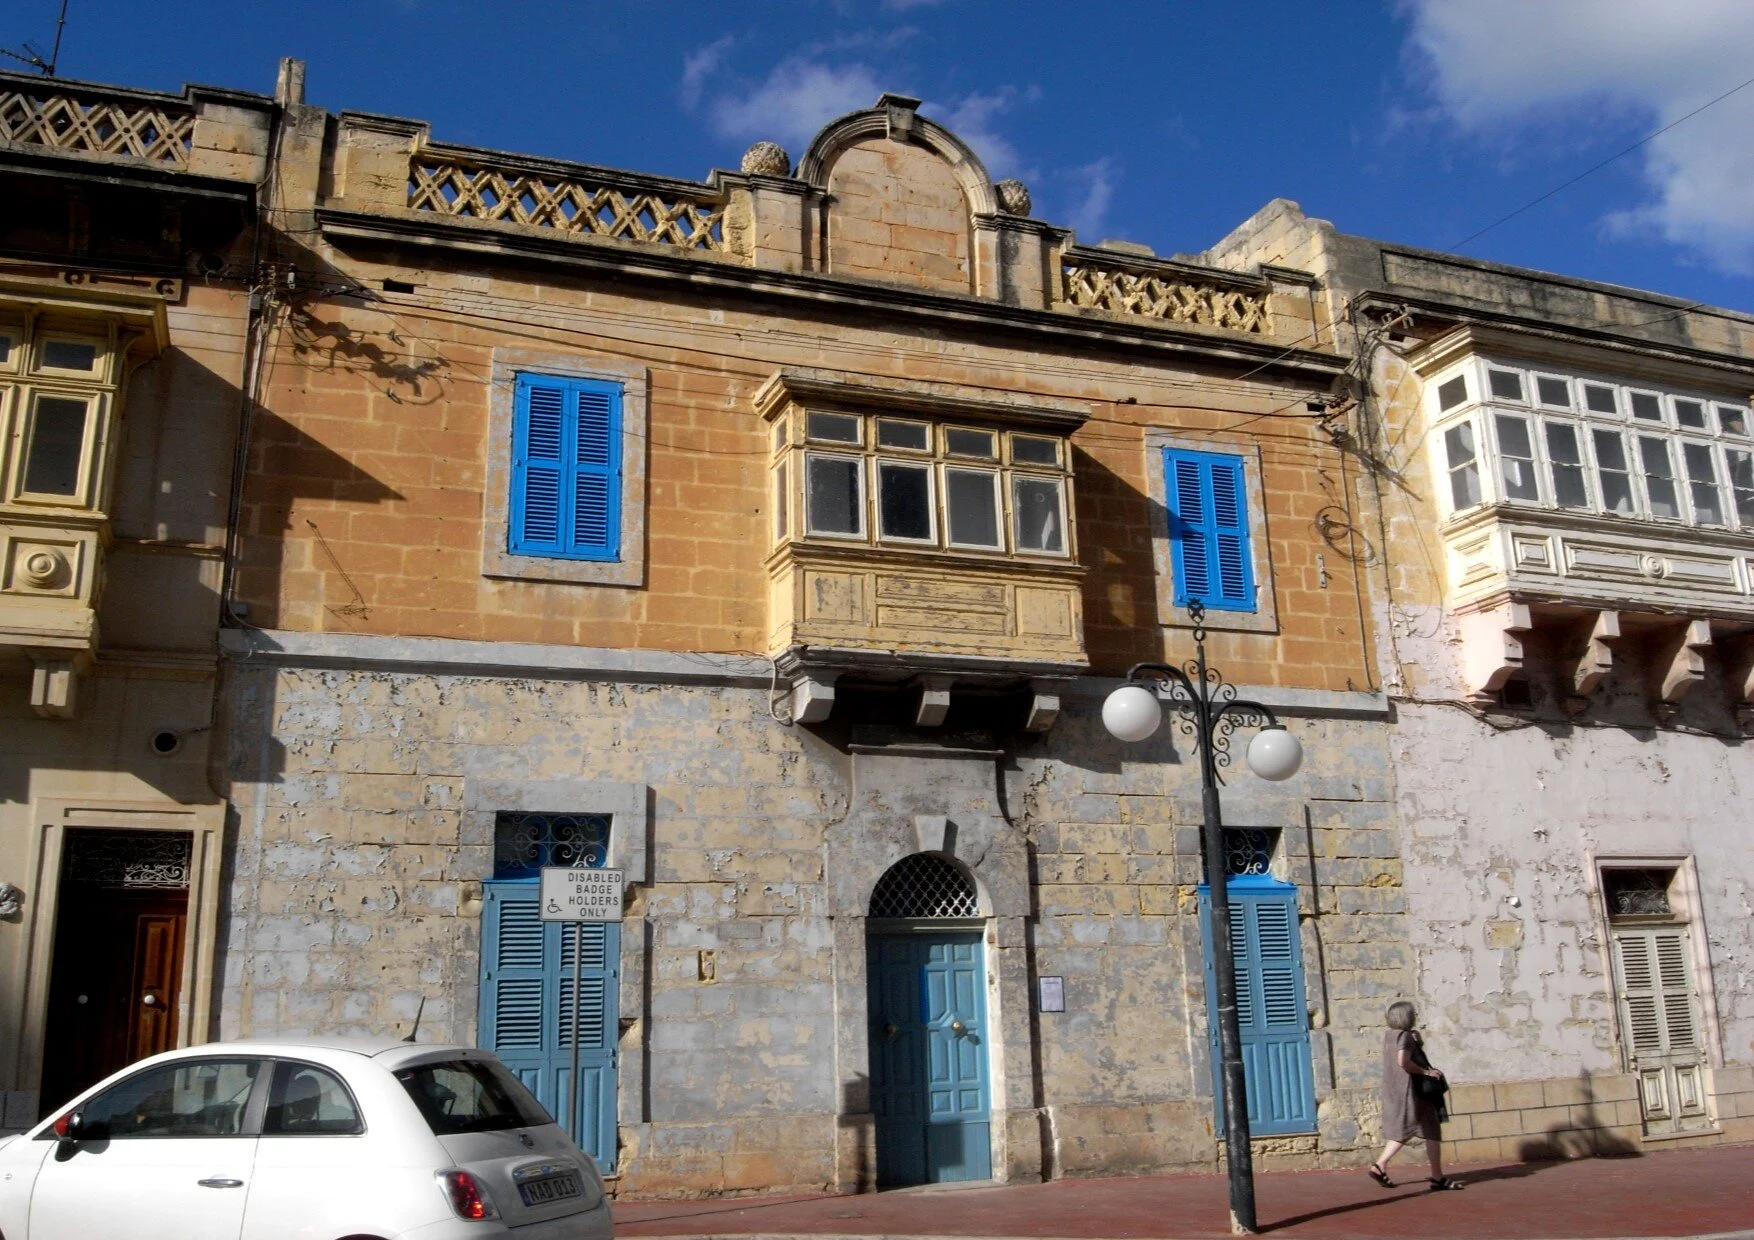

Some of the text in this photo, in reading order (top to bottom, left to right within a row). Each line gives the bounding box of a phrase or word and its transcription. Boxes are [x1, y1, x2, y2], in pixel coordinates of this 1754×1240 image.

[568, 872, 621, 883] DISABLED
[576, 884, 613, 895] BADGE
[568, 896, 619, 906] HOLDERS
[579, 907, 608, 917] ONLY
[553, 1178, 576, 1197] 013
